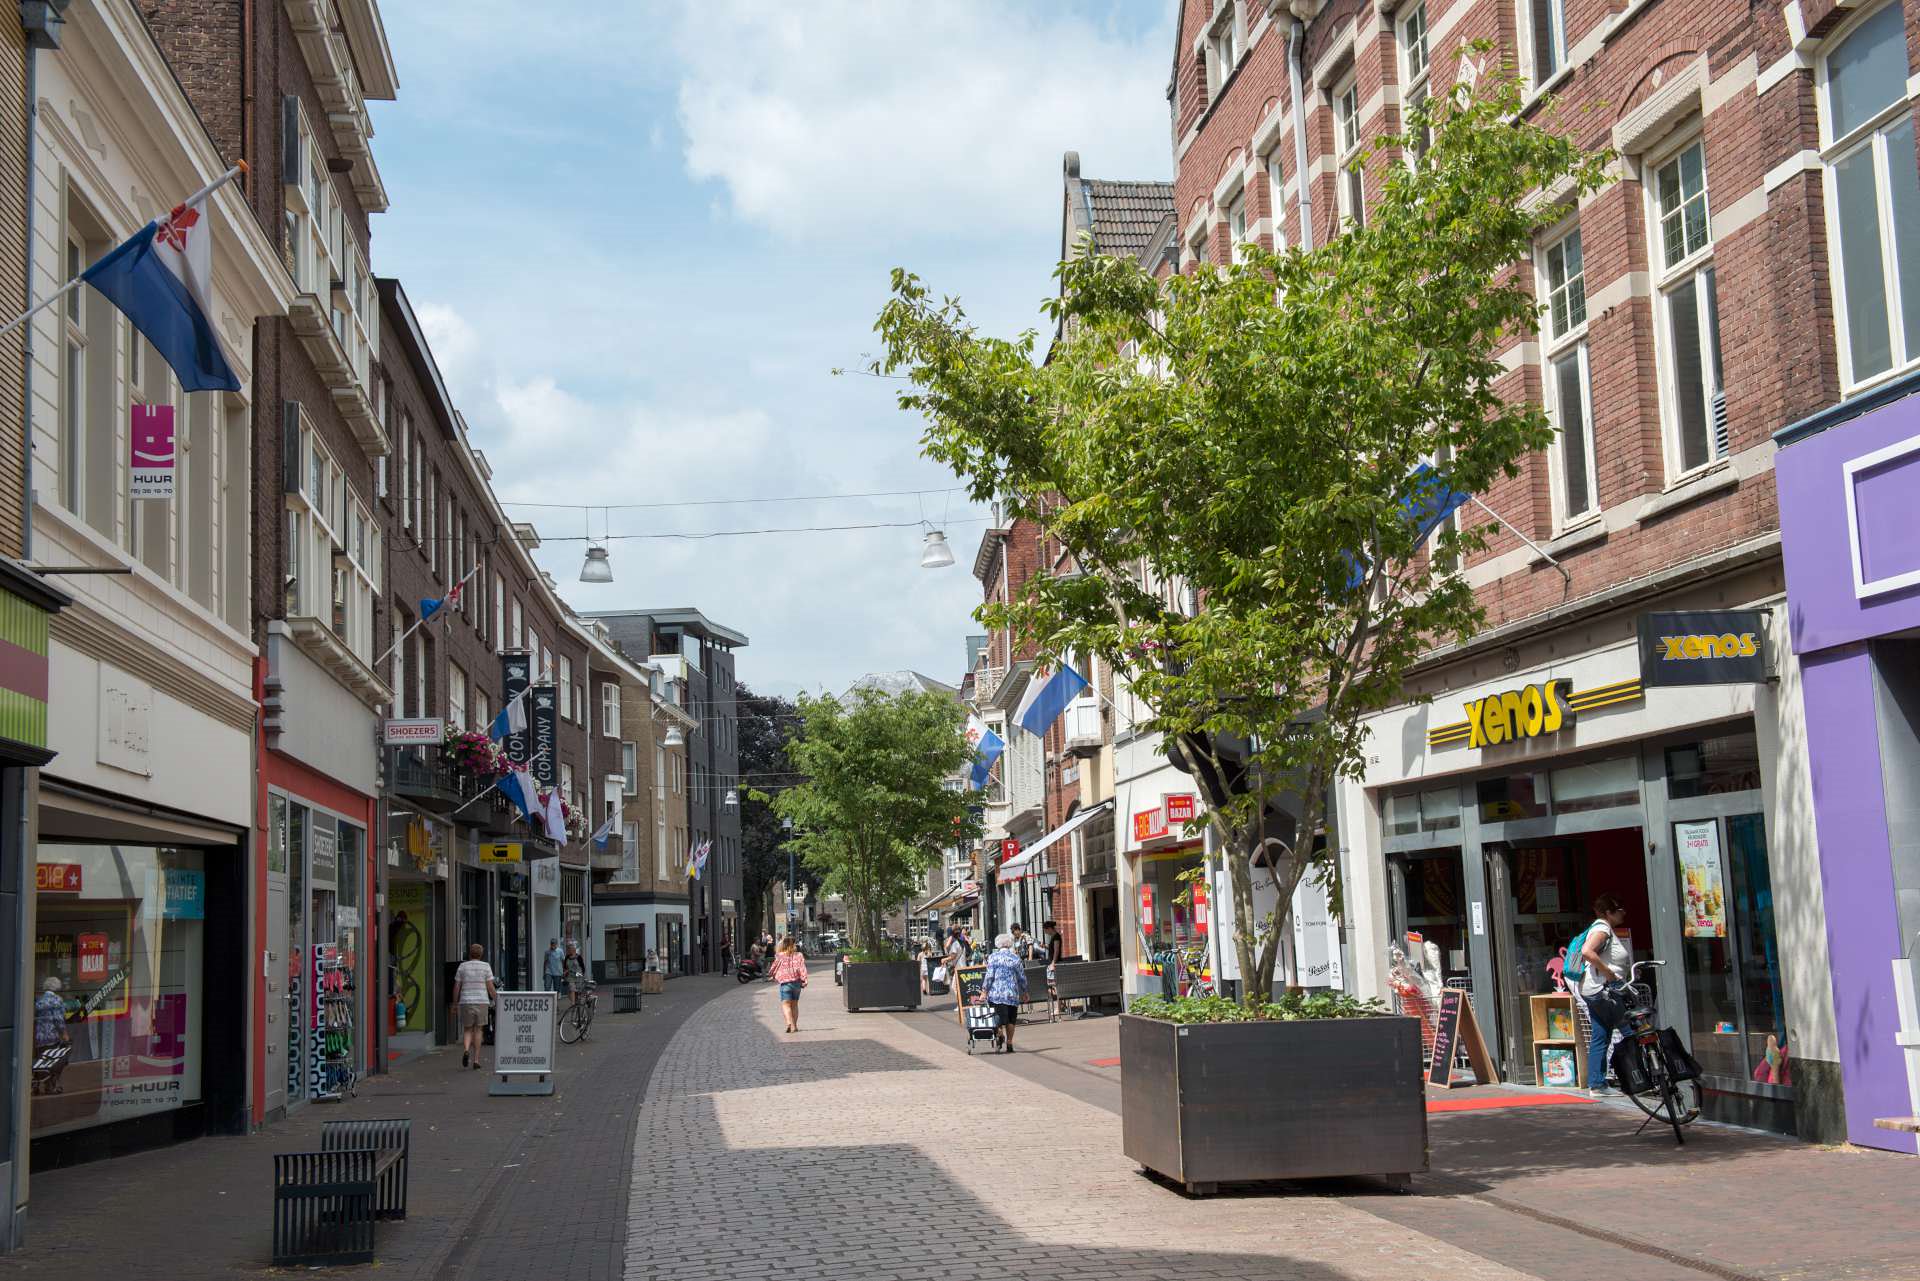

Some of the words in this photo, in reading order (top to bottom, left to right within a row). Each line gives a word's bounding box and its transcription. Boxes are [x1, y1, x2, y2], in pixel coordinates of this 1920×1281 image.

[134, 475, 173, 484] HUUR
[390, 726, 436, 736] SHOEZERS
[537, 716, 552, 781] COMPANY
[503, 998, 550, 1012] SHOEZERS
[518, 1025, 532, 1033] VOOR
[131, 1081, 180, 1093] HUUR
